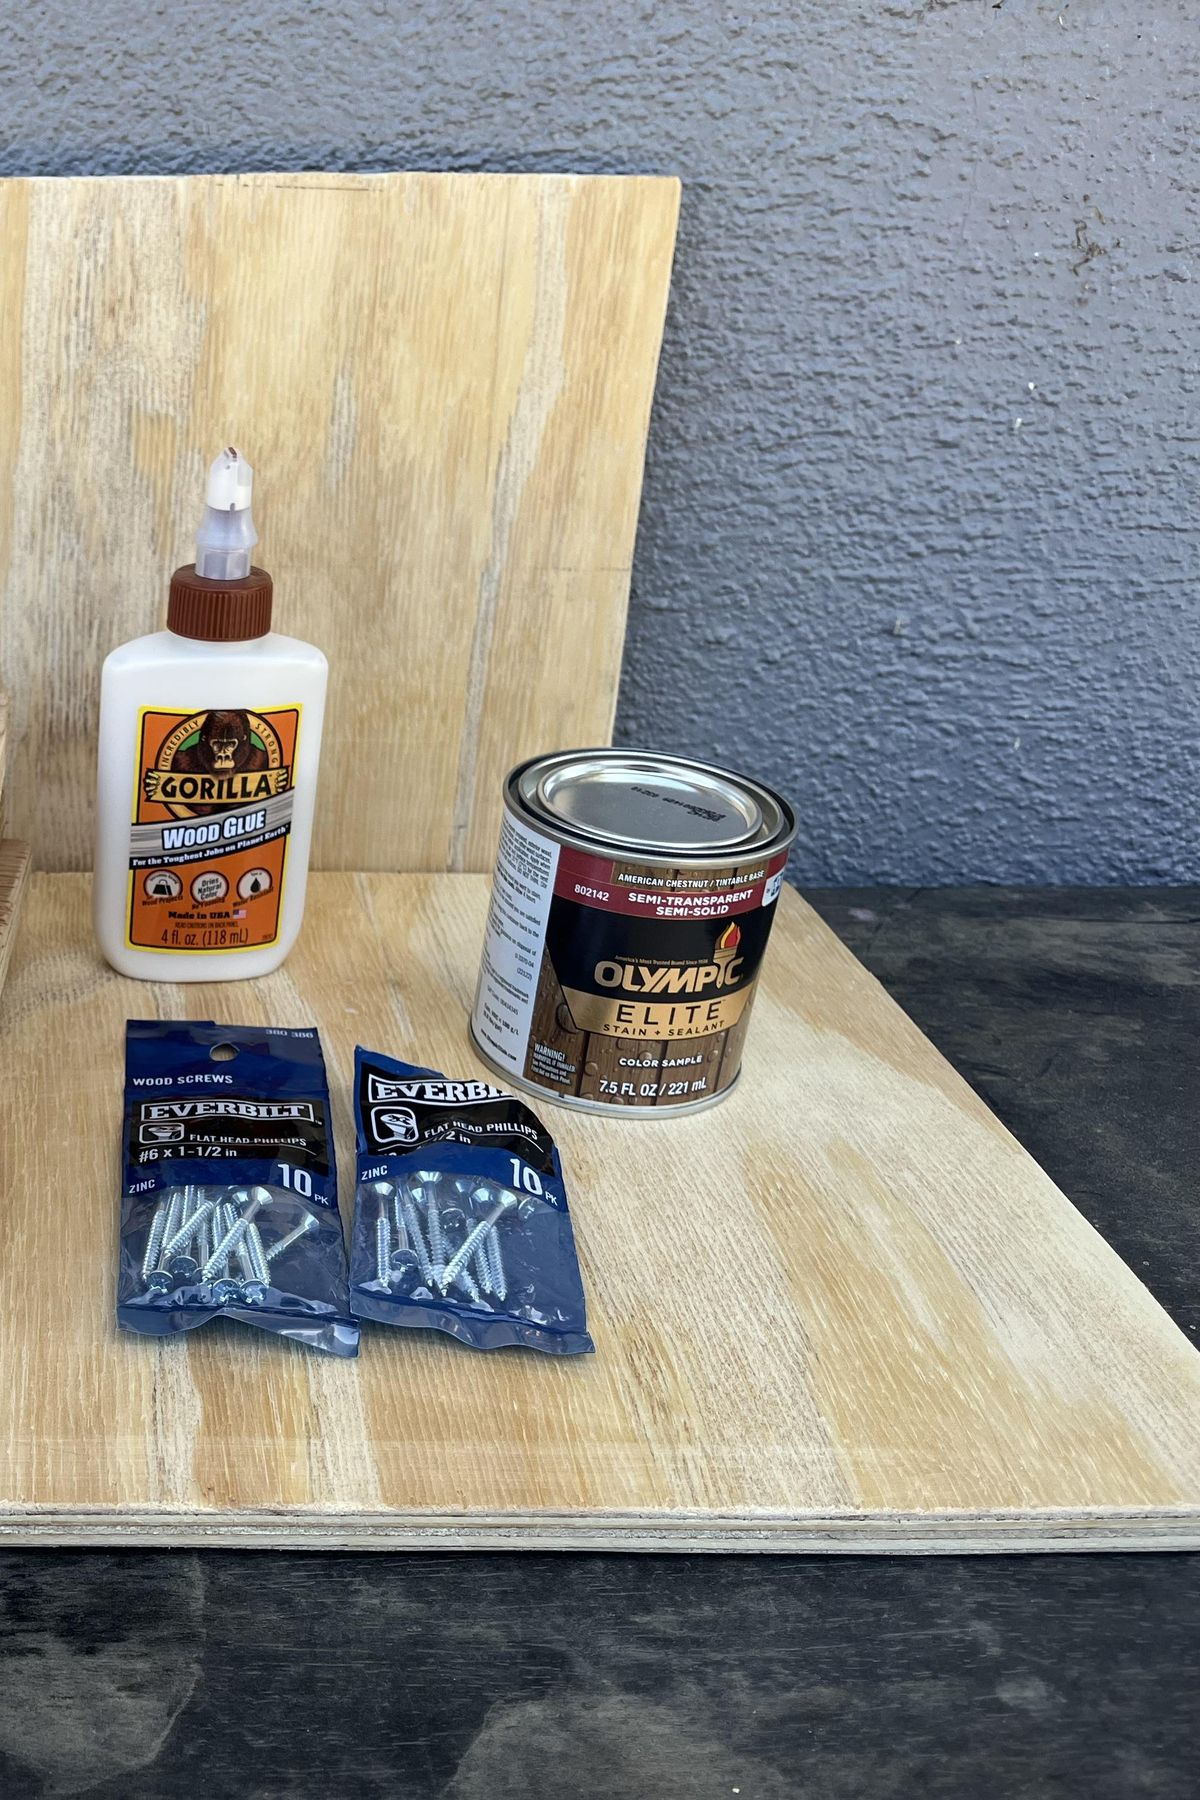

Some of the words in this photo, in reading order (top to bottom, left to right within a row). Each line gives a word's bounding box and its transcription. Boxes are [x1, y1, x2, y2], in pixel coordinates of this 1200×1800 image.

[161, 720, 199, 768] INCREDIBLY
[255, 723, 279, 764] STRONG
[160, 774, 272, 800] GORILLA
[163, 852, 203, 864] Toughest
[204, 847, 224, 857] Jobs
[225, 844, 236, 852] on
[237, 835, 264, 849] Planet
[265, 826, 286, 840] Earth
[201, 877, 219, 887] Dries
[617, 873, 664, 887] AMERICAN
[666, 877, 709, 888] CHESTNUT
[715, 874, 748, 887] TINTABLE
[748, 870, 765, 882] BASE
[198, 882, 222, 895] Natural
[200, 890, 218, 900] Color
[574, 884, 610, 902] 802142
[628, 889, 754, 906] SEMI-TRANSPARENT
[168, 911, 195, 919] Made
[196, 911, 207, 919] in
[210, 911, 230, 920] USA
[656, 905, 729, 917] SEMI-SOLID
[161, 929, 168, 942] 4
[171, 929, 181, 944] fl.
[184, 934, 199, 946] oz.
[202, 928, 227, 947] (118
[229, 928, 249, 945] mL)
[594, 956, 745, 994] OLYMPIC
[616, 1001, 722, 1025] ELITE
[603, 1023, 647, 1036] STAIN
[668, 1020, 725, 1036] SEALANT
[534, 1042, 565, 1062] WARNING!
[619, 1058, 659, 1068] COLOR
[661, 1055, 703, 1068] SAMPLE
[133, 1076, 173, 1086] WOOD
[177, 1074, 233, 1085] SCREWS
[599, 1080, 618, 1094] 7.5
[620, 1082, 636, 1096] FL
[640, 1083, 658, 1097] OZ
[667, 1081, 689, 1096] 221
[691, 1077, 707, 1092] mL
[149, 1101, 305, 1120] EVERBILT
[424, 1122, 450, 1139] FLAT
[452, 1120, 483, 1133] HEAD
[486, 1123, 539, 1141] PHILLIPS
[459, 1134, 472, 1145] in
[189, 1133, 216, 1144] FLAT
[219, 1135, 250, 1144] HEAD
[253, 1137, 308, 1147] PHILLIPS
[138, 1147, 159, 1164] #6
[163, 1148, 173, 1158] x
[178, 1146, 222, 1158] 1-1/2
[225, 1147, 238, 1157] in
[361, 1165, 388, 1180] ZINC
[129, 1179, 156, 1194] ZINC
[277, 1163, 313, 1198] 10
[314, 1194, 330, 1206] PK
[510, 1158, 544, 1196] 10
[545, 1191, 558, 1207] PK
